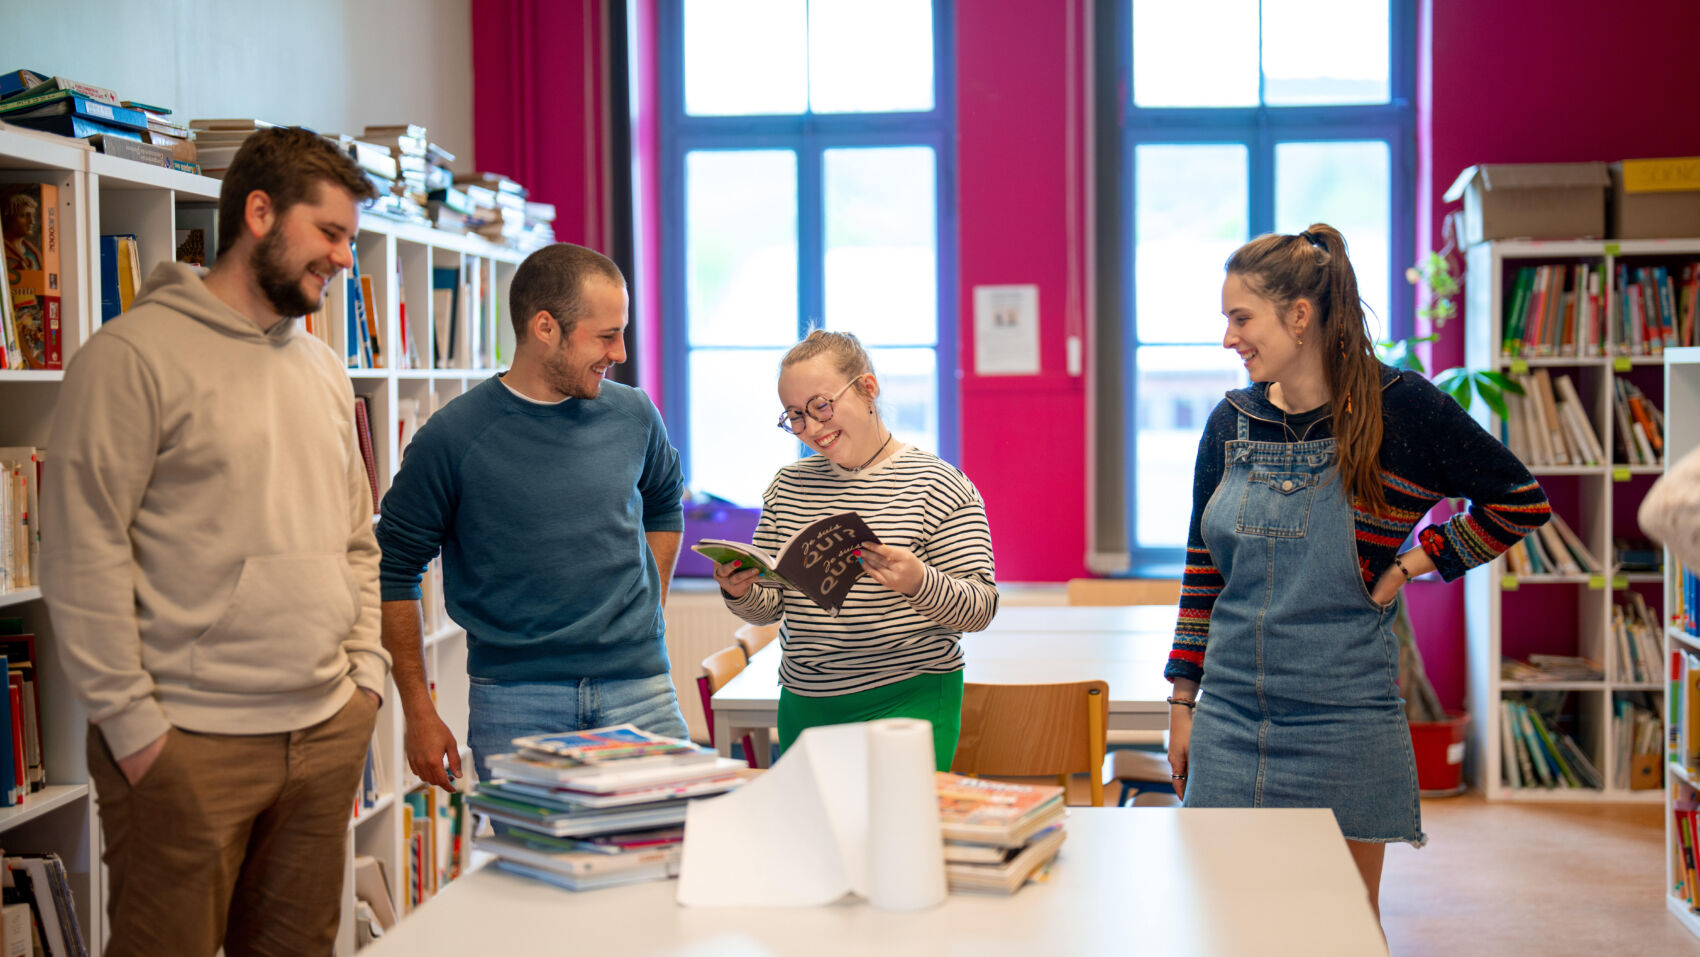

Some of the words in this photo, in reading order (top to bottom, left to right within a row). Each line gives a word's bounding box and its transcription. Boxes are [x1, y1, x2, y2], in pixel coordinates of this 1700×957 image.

[802, 539, 816, 555] Je
[817, 524, 842, 539] suis
[802, 528, 856, 569] QUI?
[823, 557, 837, 574] Je
